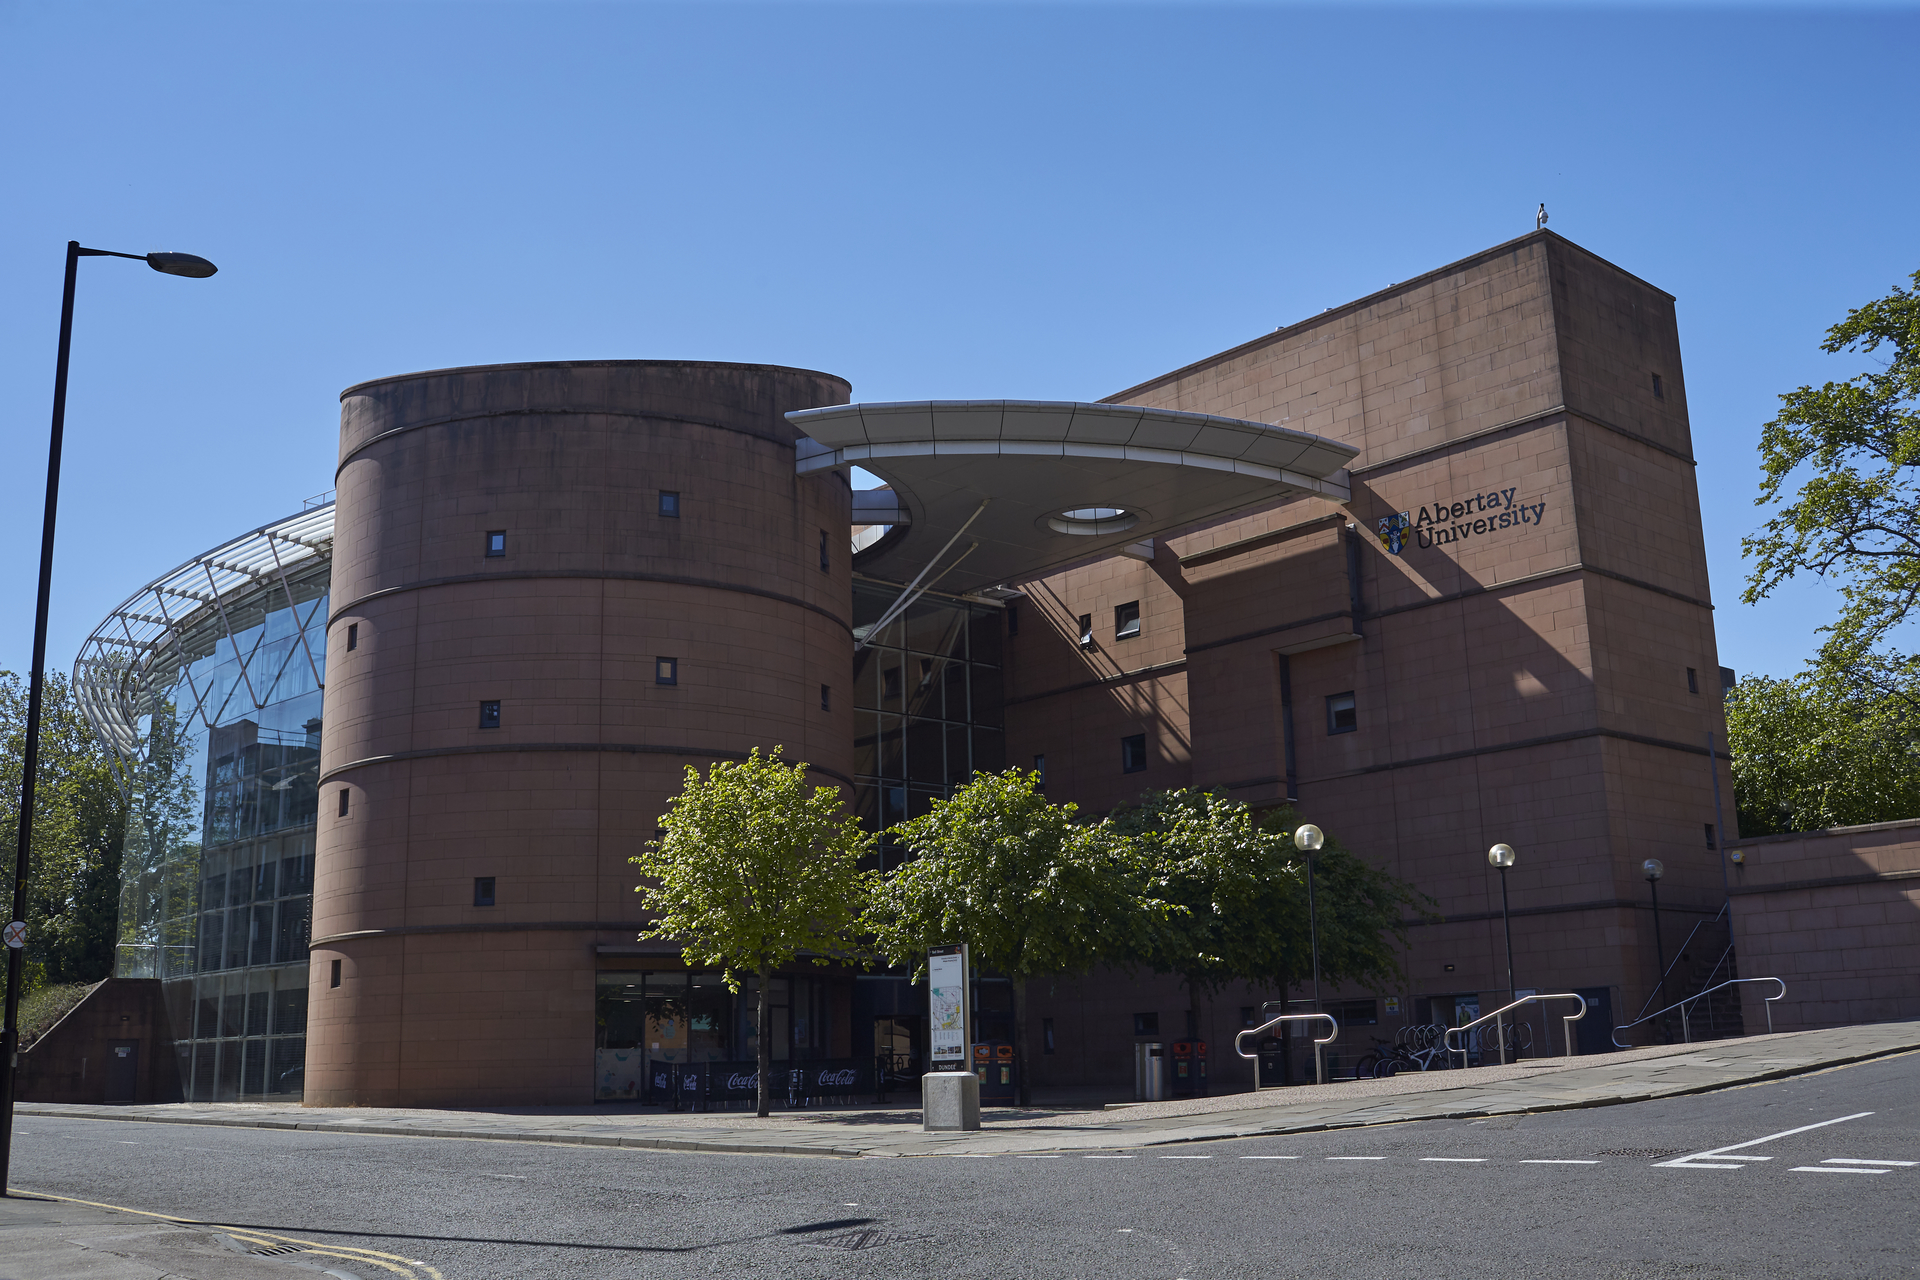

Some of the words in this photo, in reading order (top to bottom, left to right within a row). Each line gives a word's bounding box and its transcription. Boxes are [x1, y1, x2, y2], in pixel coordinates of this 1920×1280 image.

[1414, 487, 1517, 529] Abertay
[1415, 502, 1546, 549] University
[18, 879, 26, 890] 7
